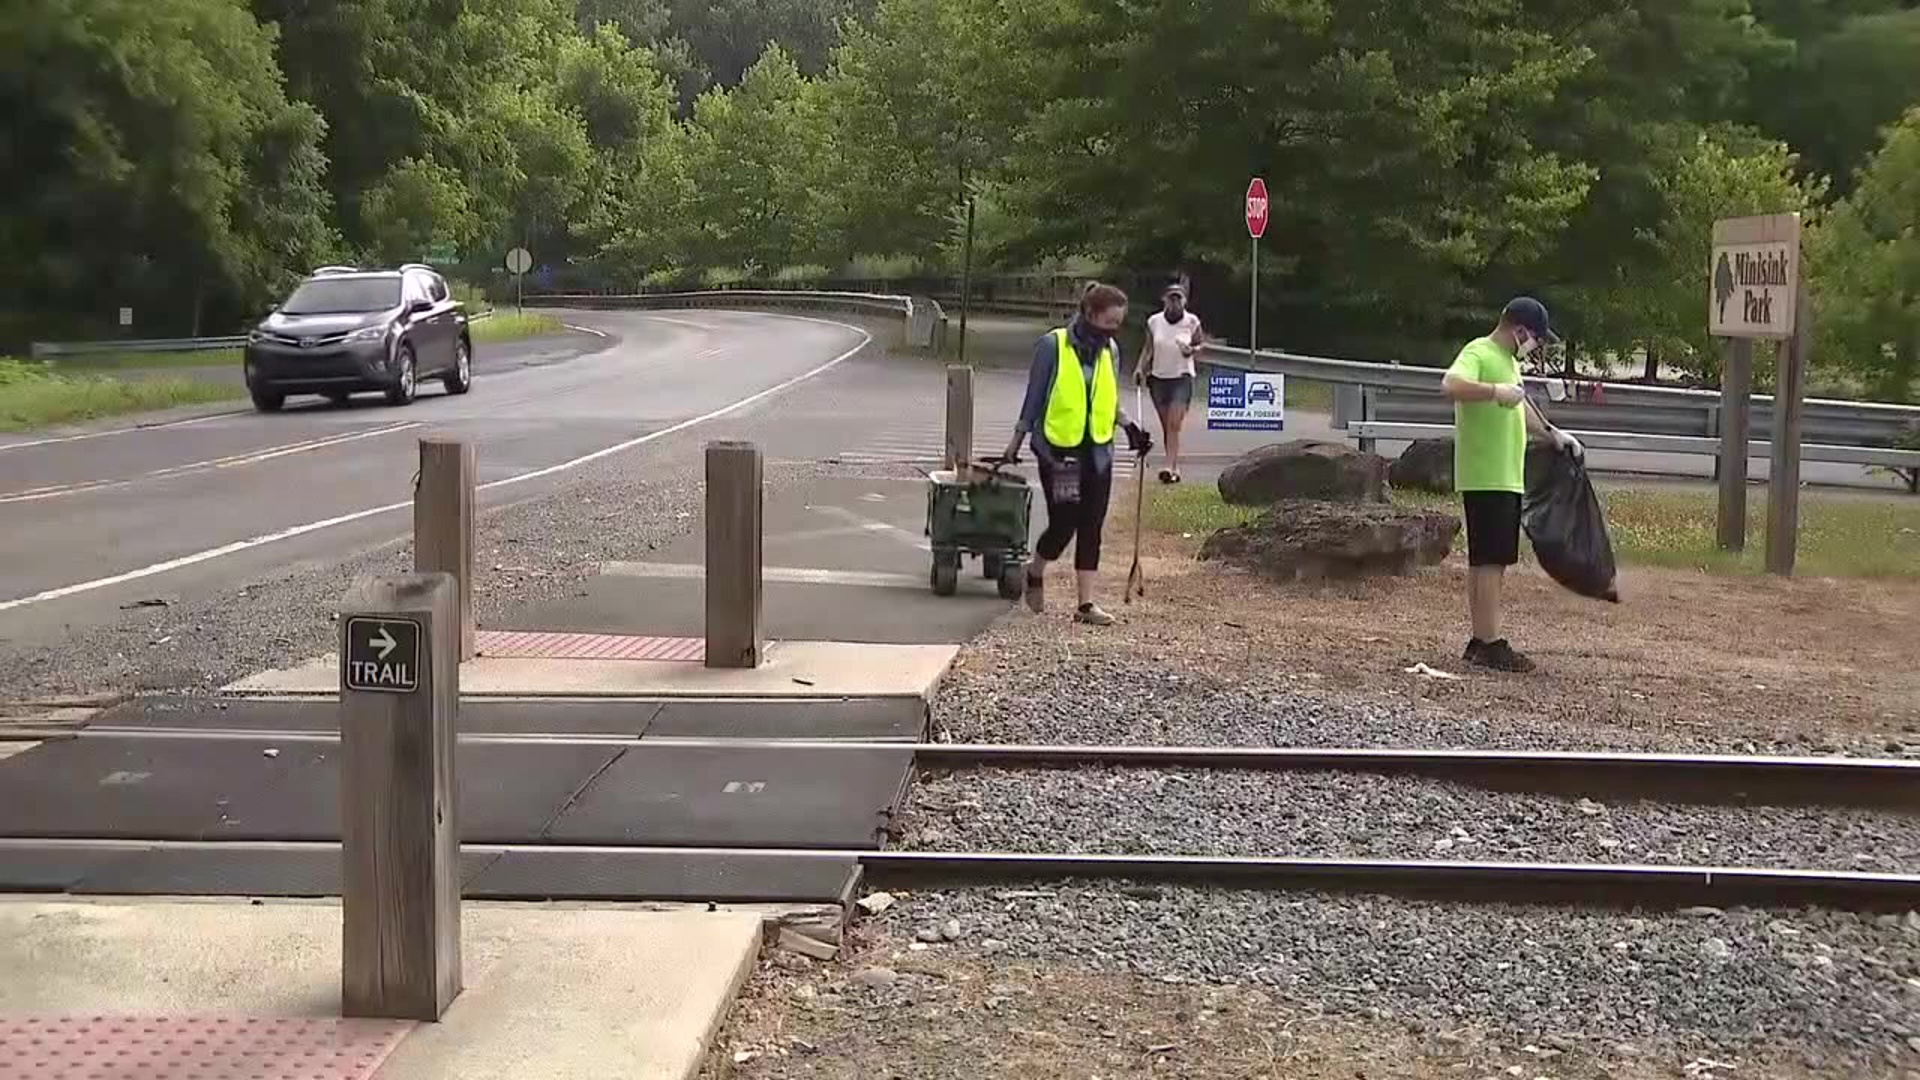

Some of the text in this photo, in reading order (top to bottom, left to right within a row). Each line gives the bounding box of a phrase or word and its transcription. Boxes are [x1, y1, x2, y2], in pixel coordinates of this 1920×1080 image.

[1248, 197, 1267, 218] STOP
[1735, 250, 1788, 286] Minisink
[1744, 288, 1772, 324] Park
[1211, 376, 1240, 385] LITTER
[1211, 387, 1232, 395] ISN'T
[1211, 397, 1243, 405] PRETTY
[1210, 410, 1234, 418] DON'T
[1235, 410, 1246, 418] BE
[351, 661, 414, 685] TRAIL
